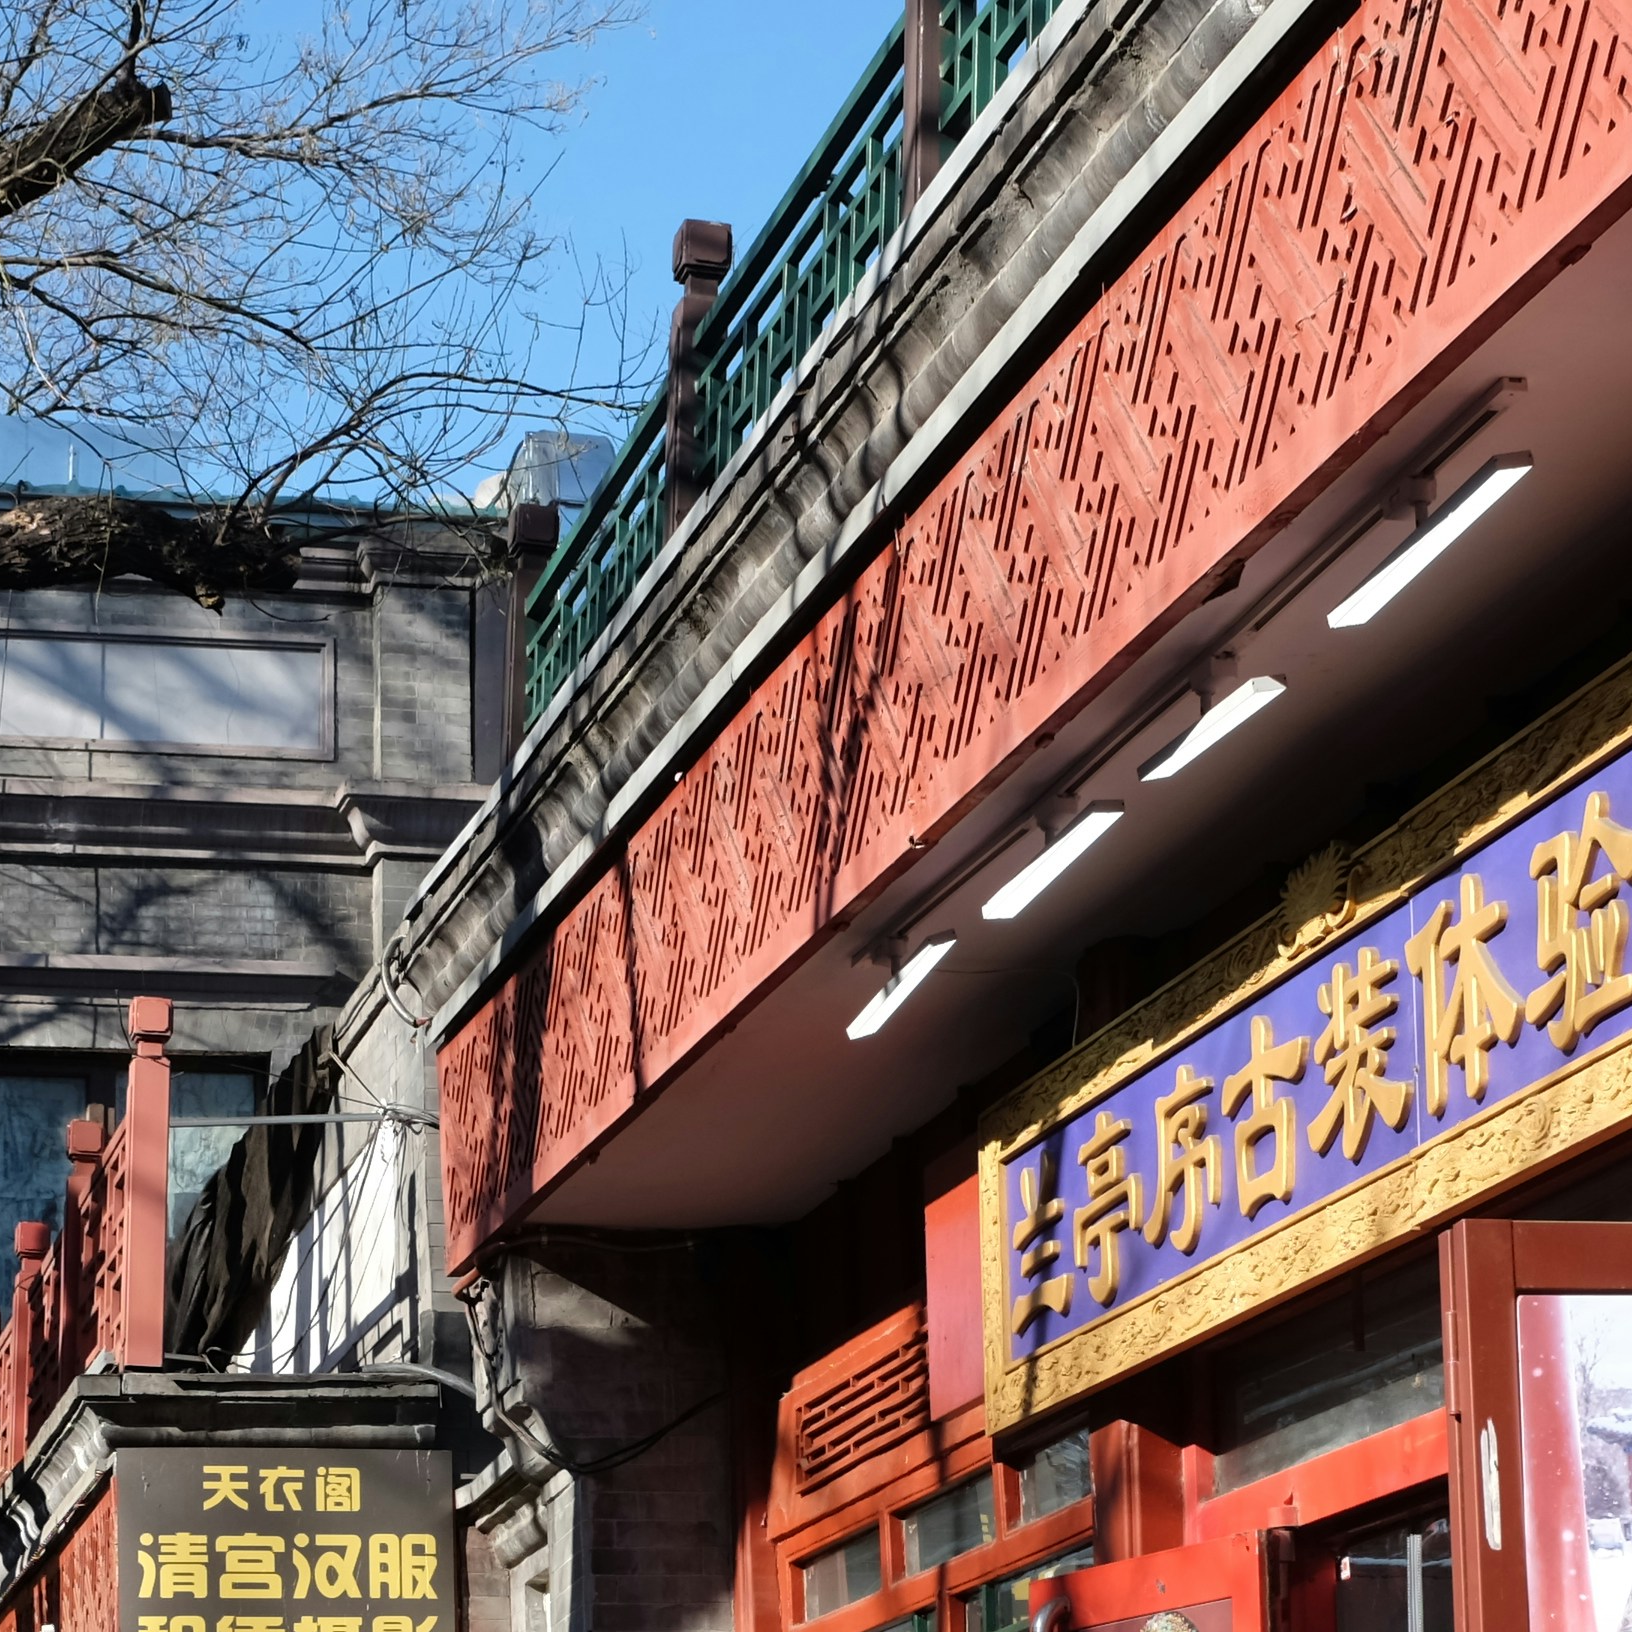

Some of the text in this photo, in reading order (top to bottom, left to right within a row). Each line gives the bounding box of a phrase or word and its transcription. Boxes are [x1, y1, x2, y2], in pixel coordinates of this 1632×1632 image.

[201, 1464, 363, 1514] 天衣阁
[136, 1531, 438, 1602] 清宫汉服
